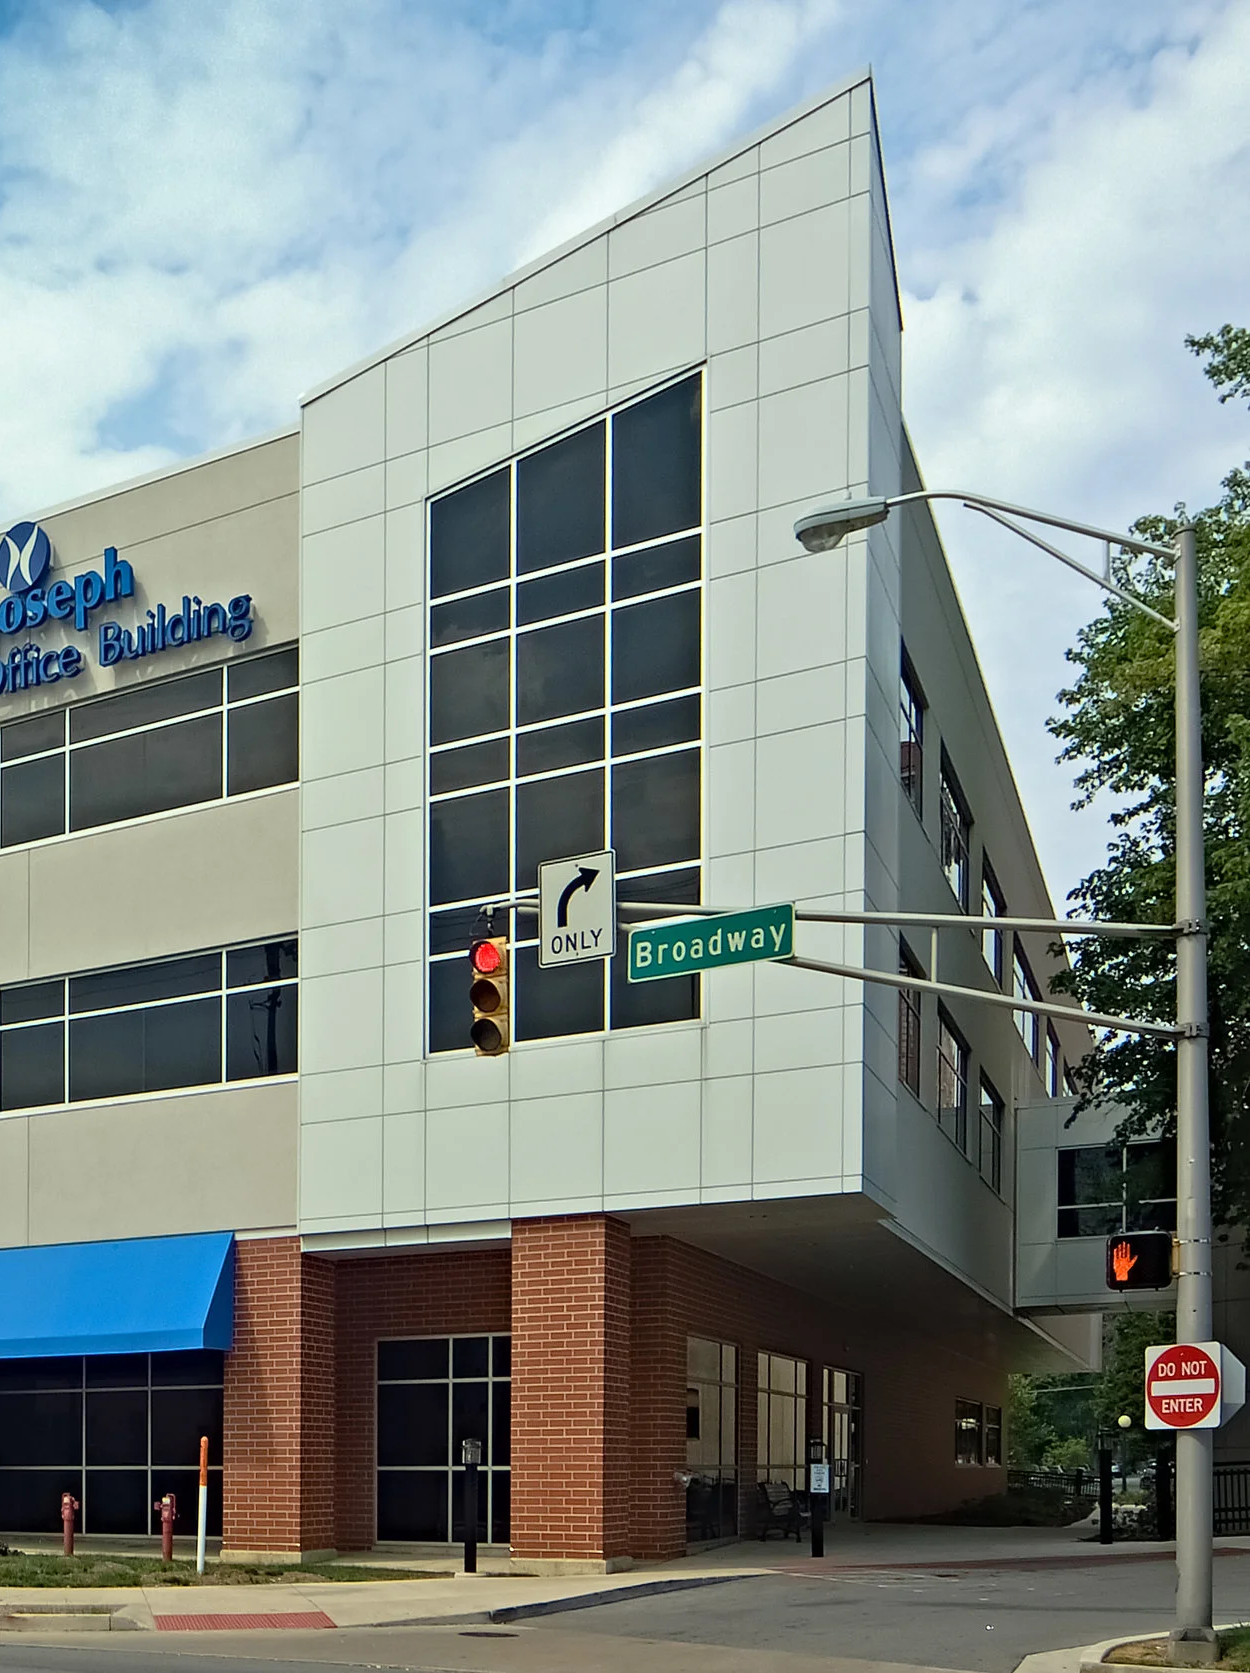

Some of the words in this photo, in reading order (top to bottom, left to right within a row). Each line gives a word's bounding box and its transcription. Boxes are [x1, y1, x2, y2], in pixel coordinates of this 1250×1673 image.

[99, 594, 253, 668] Building
[551, 927, 603, 954] ONLY
[636, 923, 786, 968] Broadway
[1158, 1362, 1176, 1377] DO
[1181, 1360, 1207, 1376] NOT
[1161, 1398, 1203, 1413] ENTER
